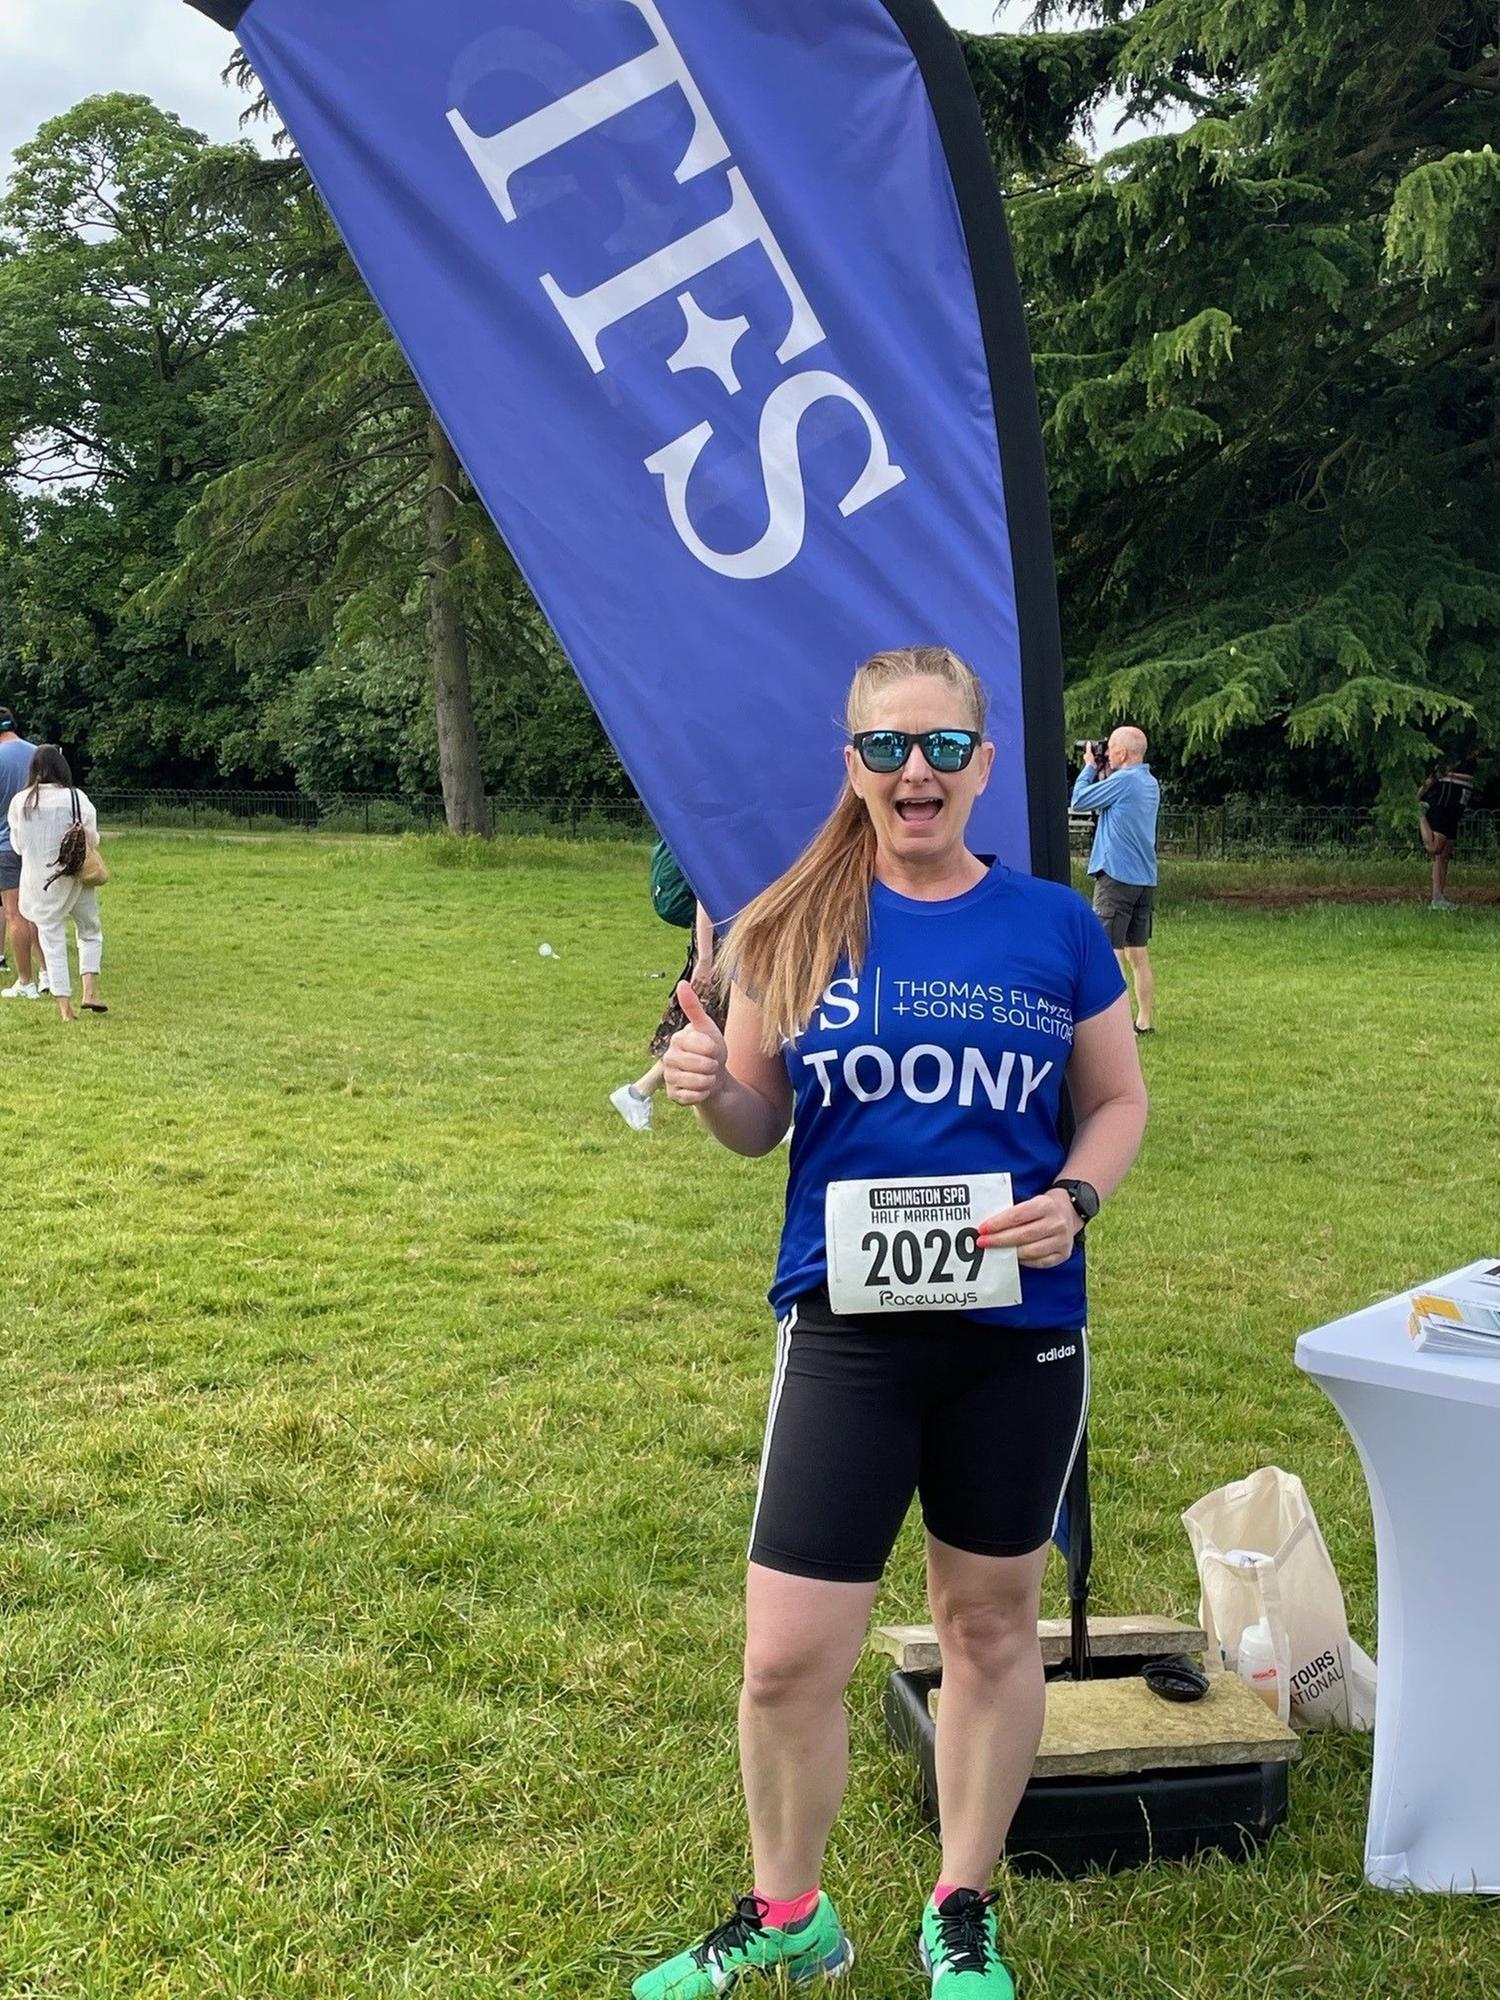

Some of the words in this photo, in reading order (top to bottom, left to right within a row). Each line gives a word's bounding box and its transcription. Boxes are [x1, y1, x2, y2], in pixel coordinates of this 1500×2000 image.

[893, 980, 1004, 1003] THOMAS
[992, 1005, 1074, 1046] SOLICITOR
[802, 1044, 1054, 1113] TOONY
[874, 1188, 941, 1207] LEAMINGTON
[943, 1186, 967, 1204] SPA
[871, 1209, 900, 1224] HALF
[904, 1206, 972, 1223] MARATHON
[861, 1226, 986, 1287] 2029
[879, 1289, 978, 1307] Raceways
[1036, 1344, 1077, 1363] adidas
[1289, 1650, 1335, 1691] TOURS
[1289, 1666, 1345, 1706] ATIONAL
